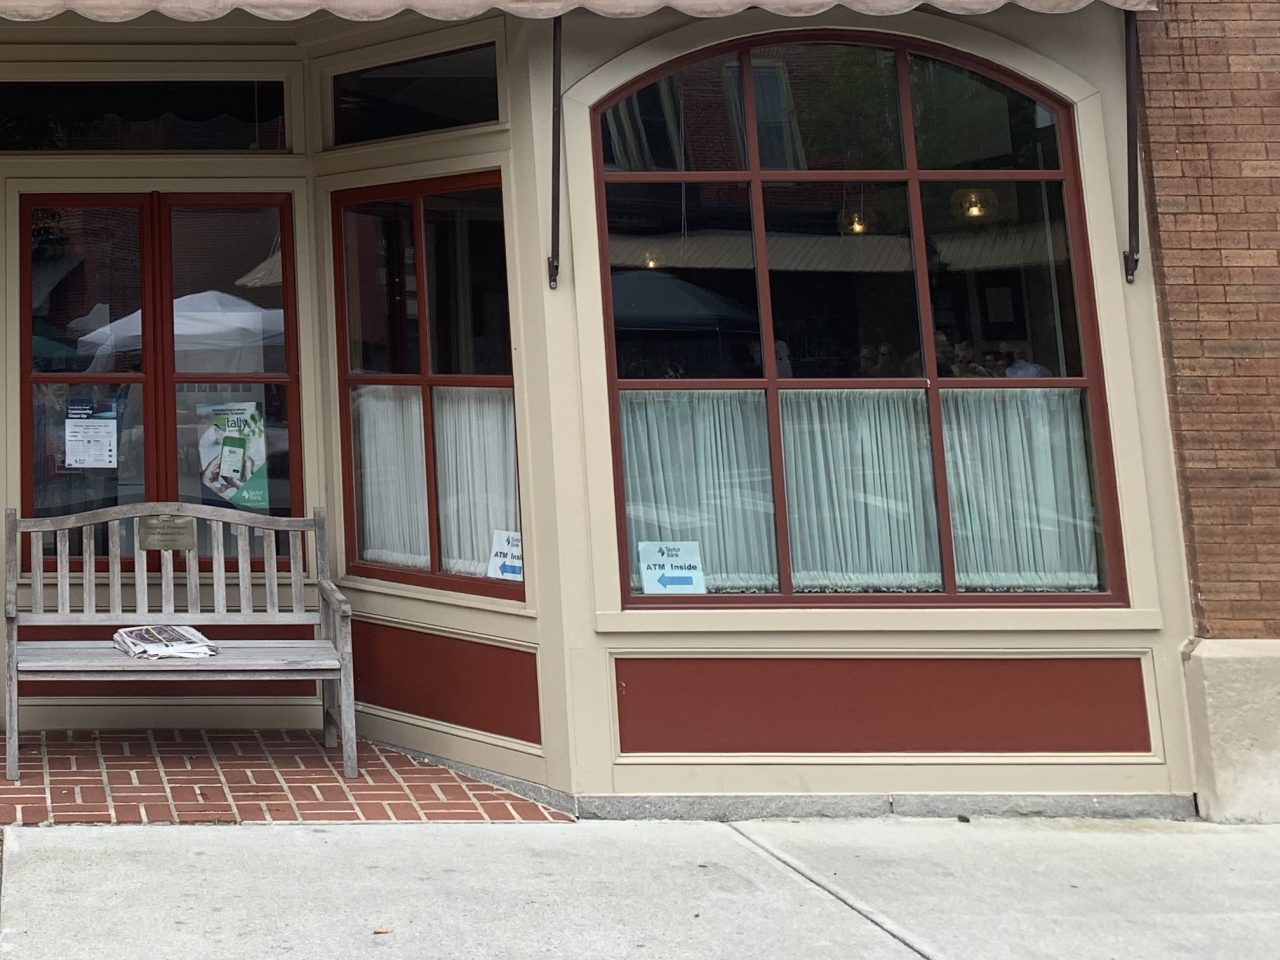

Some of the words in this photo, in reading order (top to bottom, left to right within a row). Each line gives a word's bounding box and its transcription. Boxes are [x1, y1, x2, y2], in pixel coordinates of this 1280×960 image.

[227, 416, 248, 431] tally
[494, 551, 508, 559] ATM
[510, 552, 522, 561] Insi
[646, 563, 666, 571] ATM
[670, 563, 698, 571] Inside
